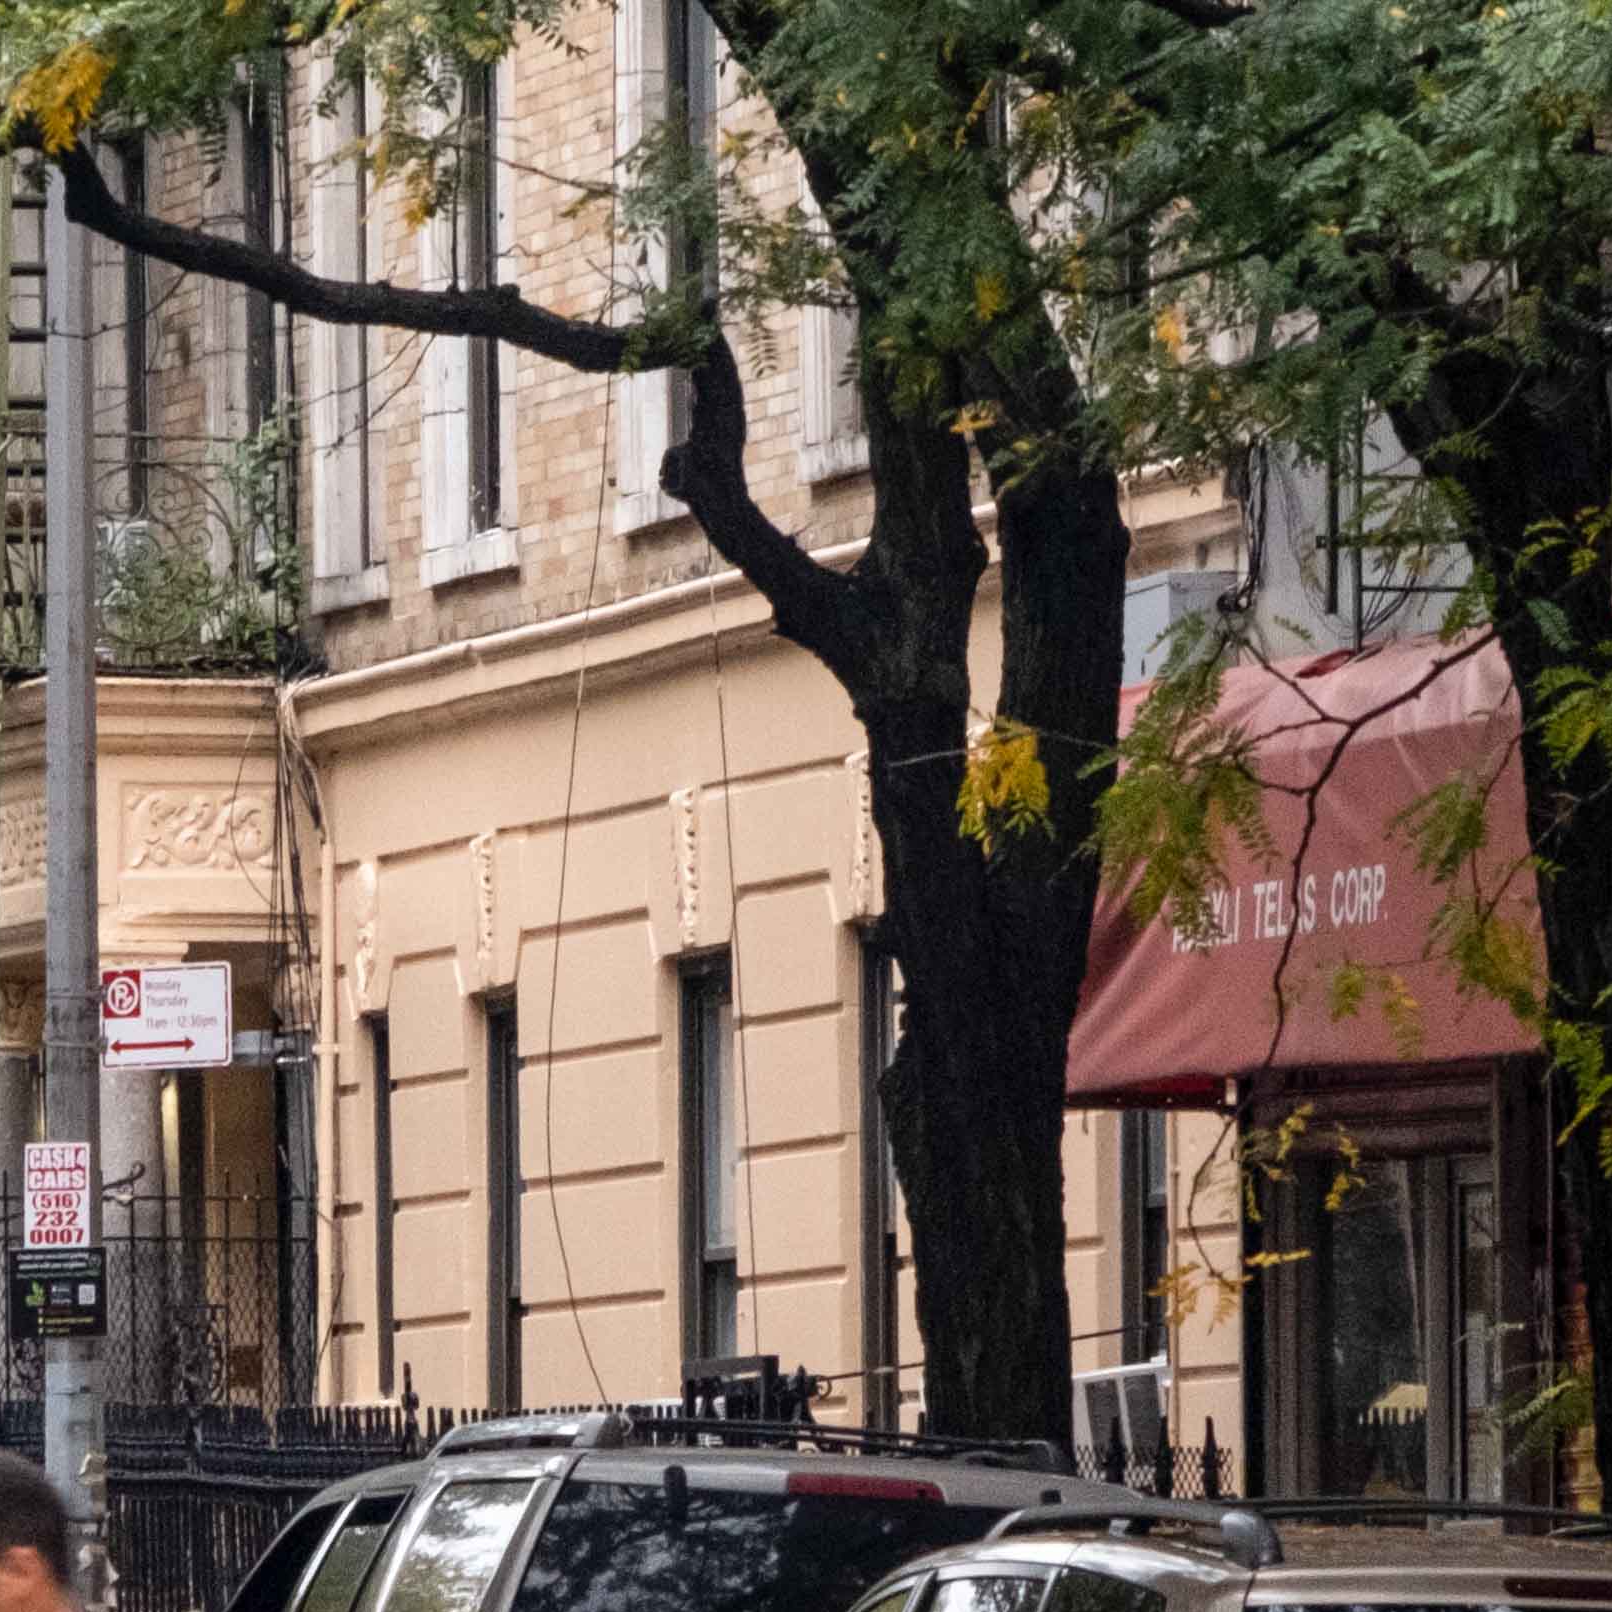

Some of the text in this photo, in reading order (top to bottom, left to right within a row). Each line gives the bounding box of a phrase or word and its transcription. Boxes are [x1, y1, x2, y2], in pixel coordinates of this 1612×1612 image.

[1330, 863, 1389, 929] CORP.
[28, 1169, 86, 1190] CARS
[32, 1193, 81, 1209] (516)
[36, 1211, 78, 1227] 232
[30, 1229, 84, 1244] 0007
